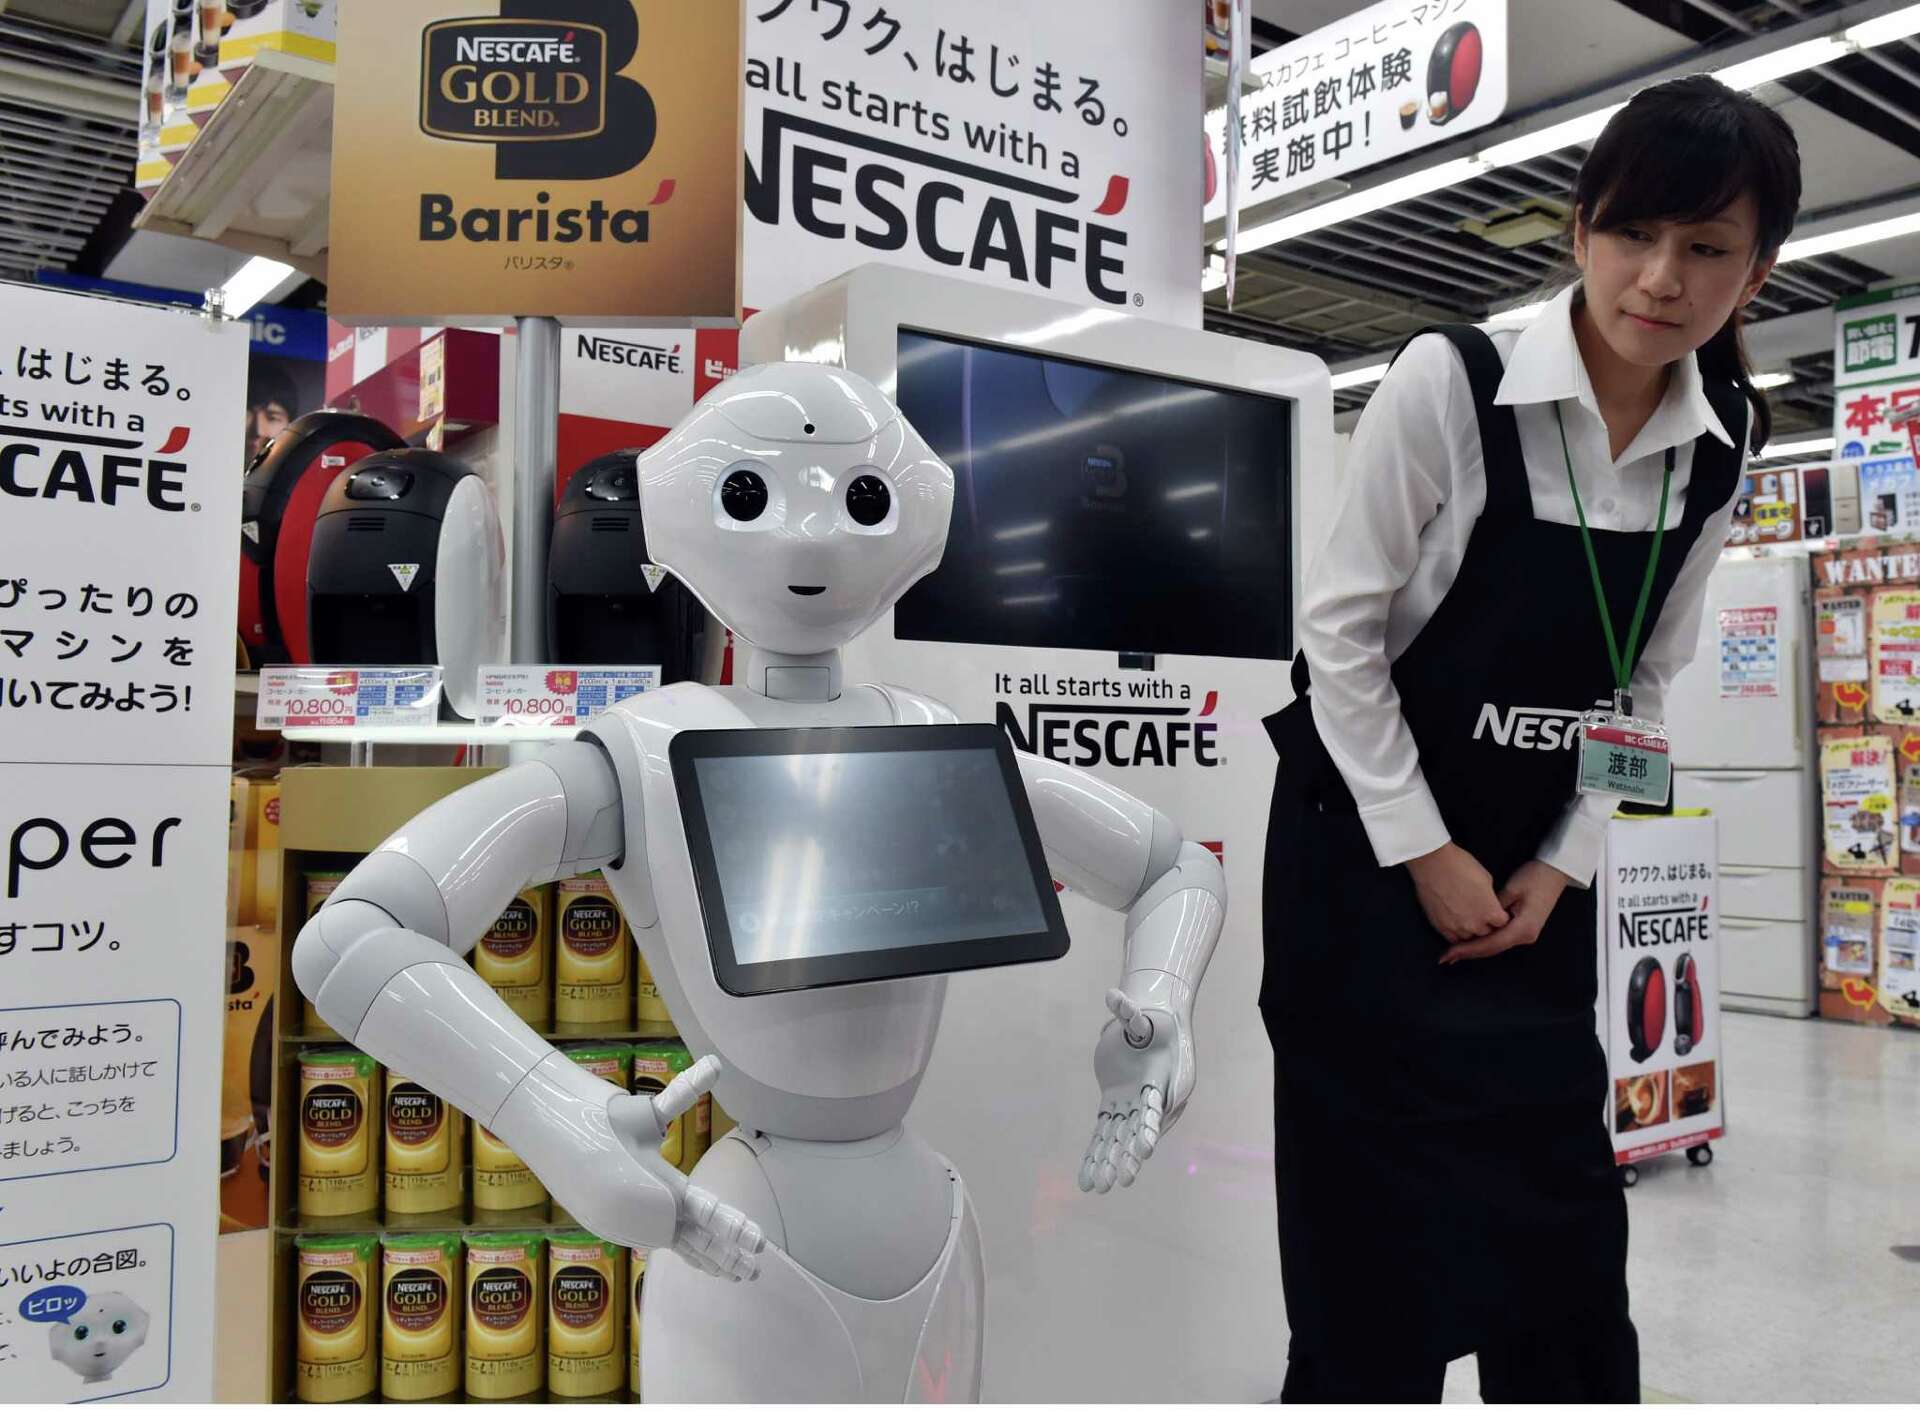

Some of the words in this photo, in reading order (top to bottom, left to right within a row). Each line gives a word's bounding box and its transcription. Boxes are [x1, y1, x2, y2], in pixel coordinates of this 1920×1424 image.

[456, 32, 574, 63] NESCAFÉ
[440, 65, 590, 104] GOLD
[745, 57, 807, 102] all
[822, 79, 950, 141] starts
[963, 122, 1047, 170] with
[1060, 150, 1080, 178] a
[41, 402, 116, 429] with
[127, 414, 145, 433] a
[0, 677, 191, 713] いてみよう!
[995, 673, 1012, 694] It
[1020, 674, 1049, 695] all
[1056, 677, 1122, 698] starts
[1128, 678, 1173, 700] with
[1179, 684, 1191, 700] a
[1608, 751, 1649, 779] 渡部
[8, 817, 182, 898] per
[1628, 894, 1640, 907] all
[1642, 894, 1669, 906] starts
[1671, 891, 1691, 904] with
[570, 919, 612, 931] GOLD
[309, 1107, 352, 1121] GOLD
[391, 1105, 432, 1119] GOLD
[0, 1137, 81, 1159] ましょう。
[307, 1294, 350, 1307] GOLD
[394, 1292, 437, 1304] GOLD
[479, 1290, 522, 1304] GOLD
[557, 1288, 599, 1302] GOLD
